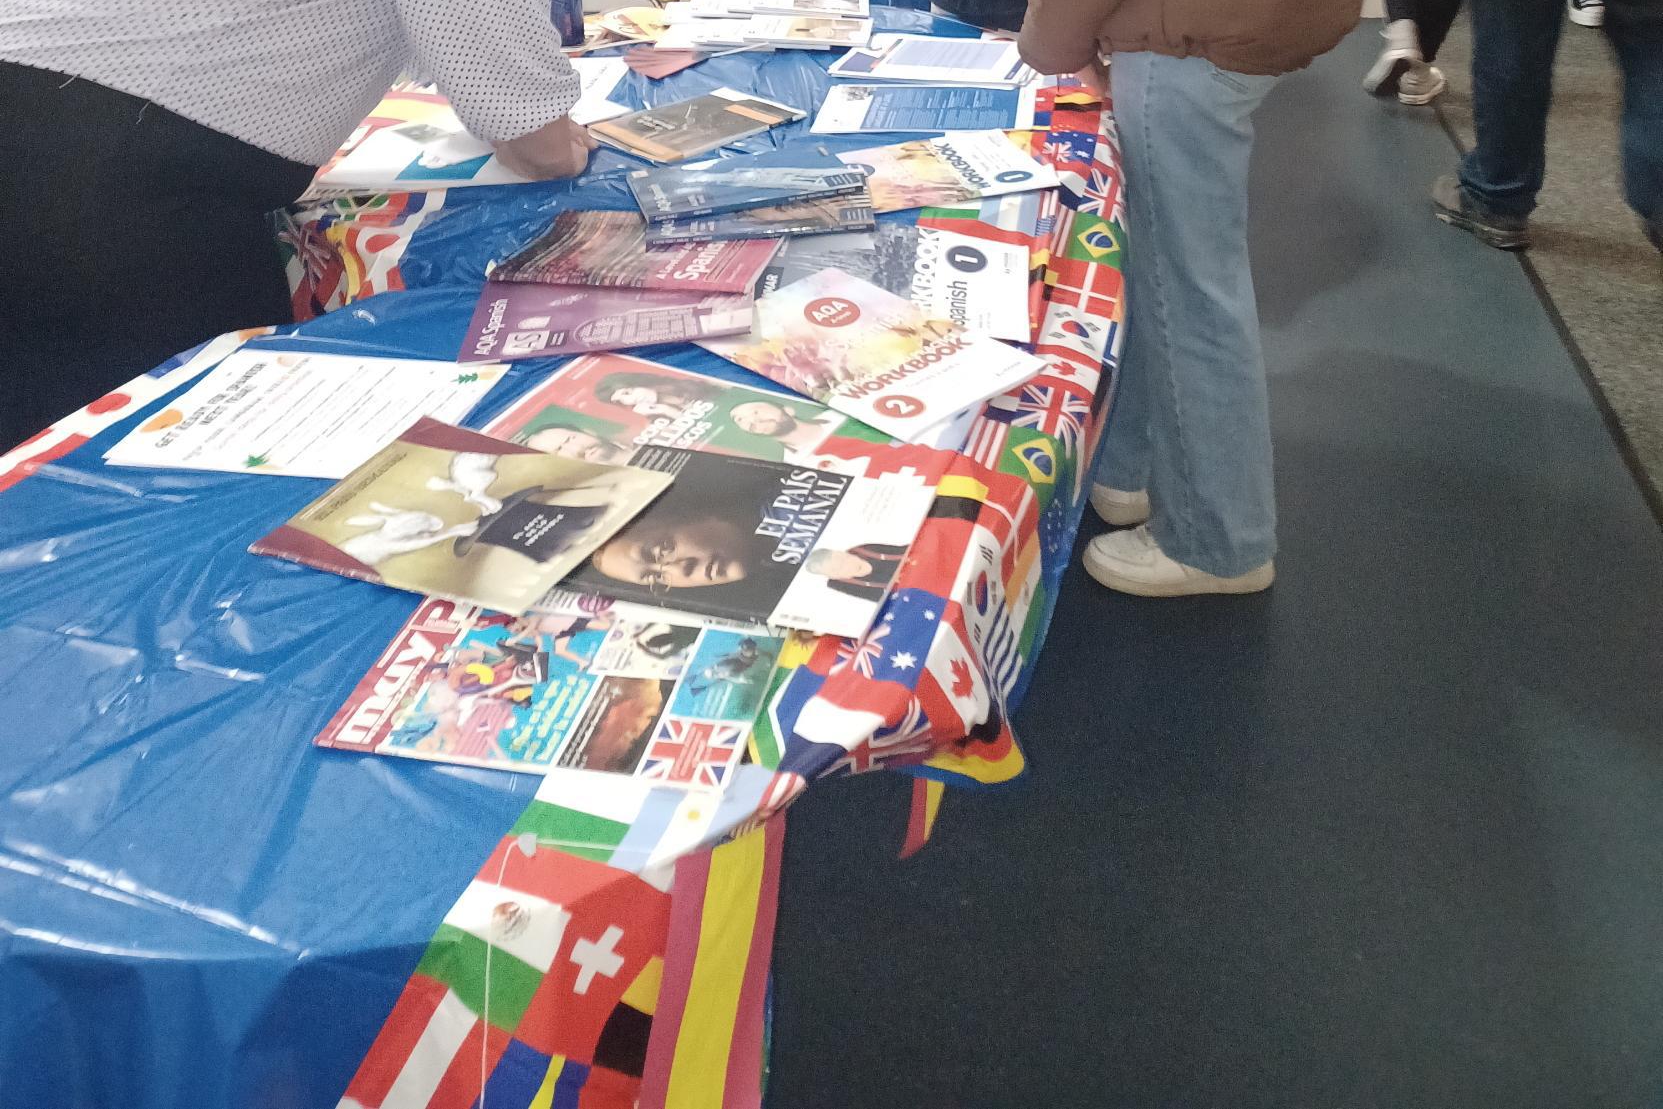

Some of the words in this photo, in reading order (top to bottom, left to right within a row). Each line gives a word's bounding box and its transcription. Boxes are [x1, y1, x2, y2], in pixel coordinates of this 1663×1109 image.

[934, 143, 991, 189] WORKBOOK
[673, 241, 728, 280] Spanis
[910, 227, 940, 310] RKBOOK
[762, 274, 778, 294] MAR
[482, 298, 508, 334] Spanish
[811, 300, 849, 322] AQA
[473, 334, 498, 355] AQA
[840, 336, 974, 400] WORKBOOK
[648, 401, 714, 447] LLIDOS
[885, 399, 915, 415] 2
[674, 421, 712, 449] SCOS
[772, 469, 818, 511] PAÍS
[755, 513, 793, 538] EL
[772, 476, 848, 565] SEMANAL
[335, 630, 437, 744] muy
